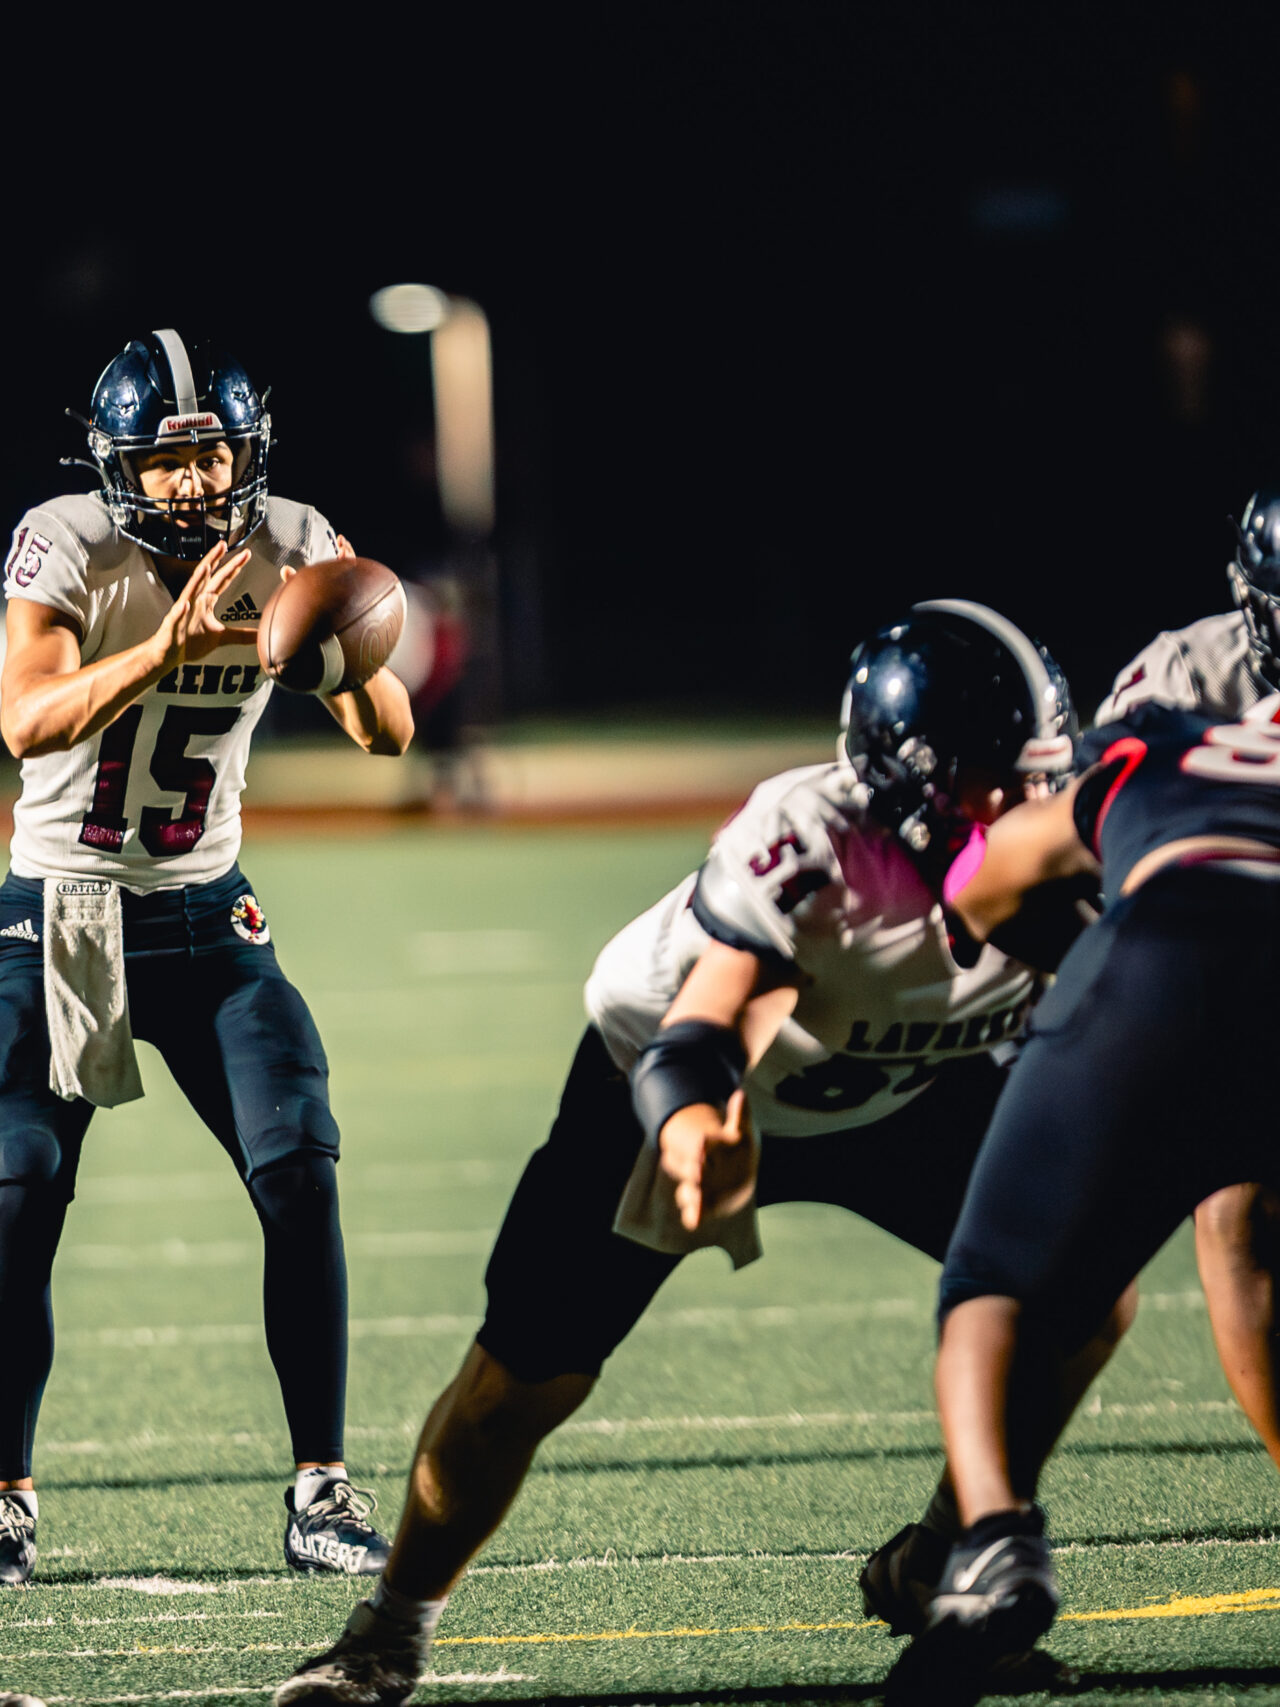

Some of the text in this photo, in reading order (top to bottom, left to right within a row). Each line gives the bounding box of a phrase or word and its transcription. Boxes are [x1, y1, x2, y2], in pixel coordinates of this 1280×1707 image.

[7, 526, 53, 588] 15
[78, 704, 242, 858] 15
[61, 883, 108, 894] BATTLE
